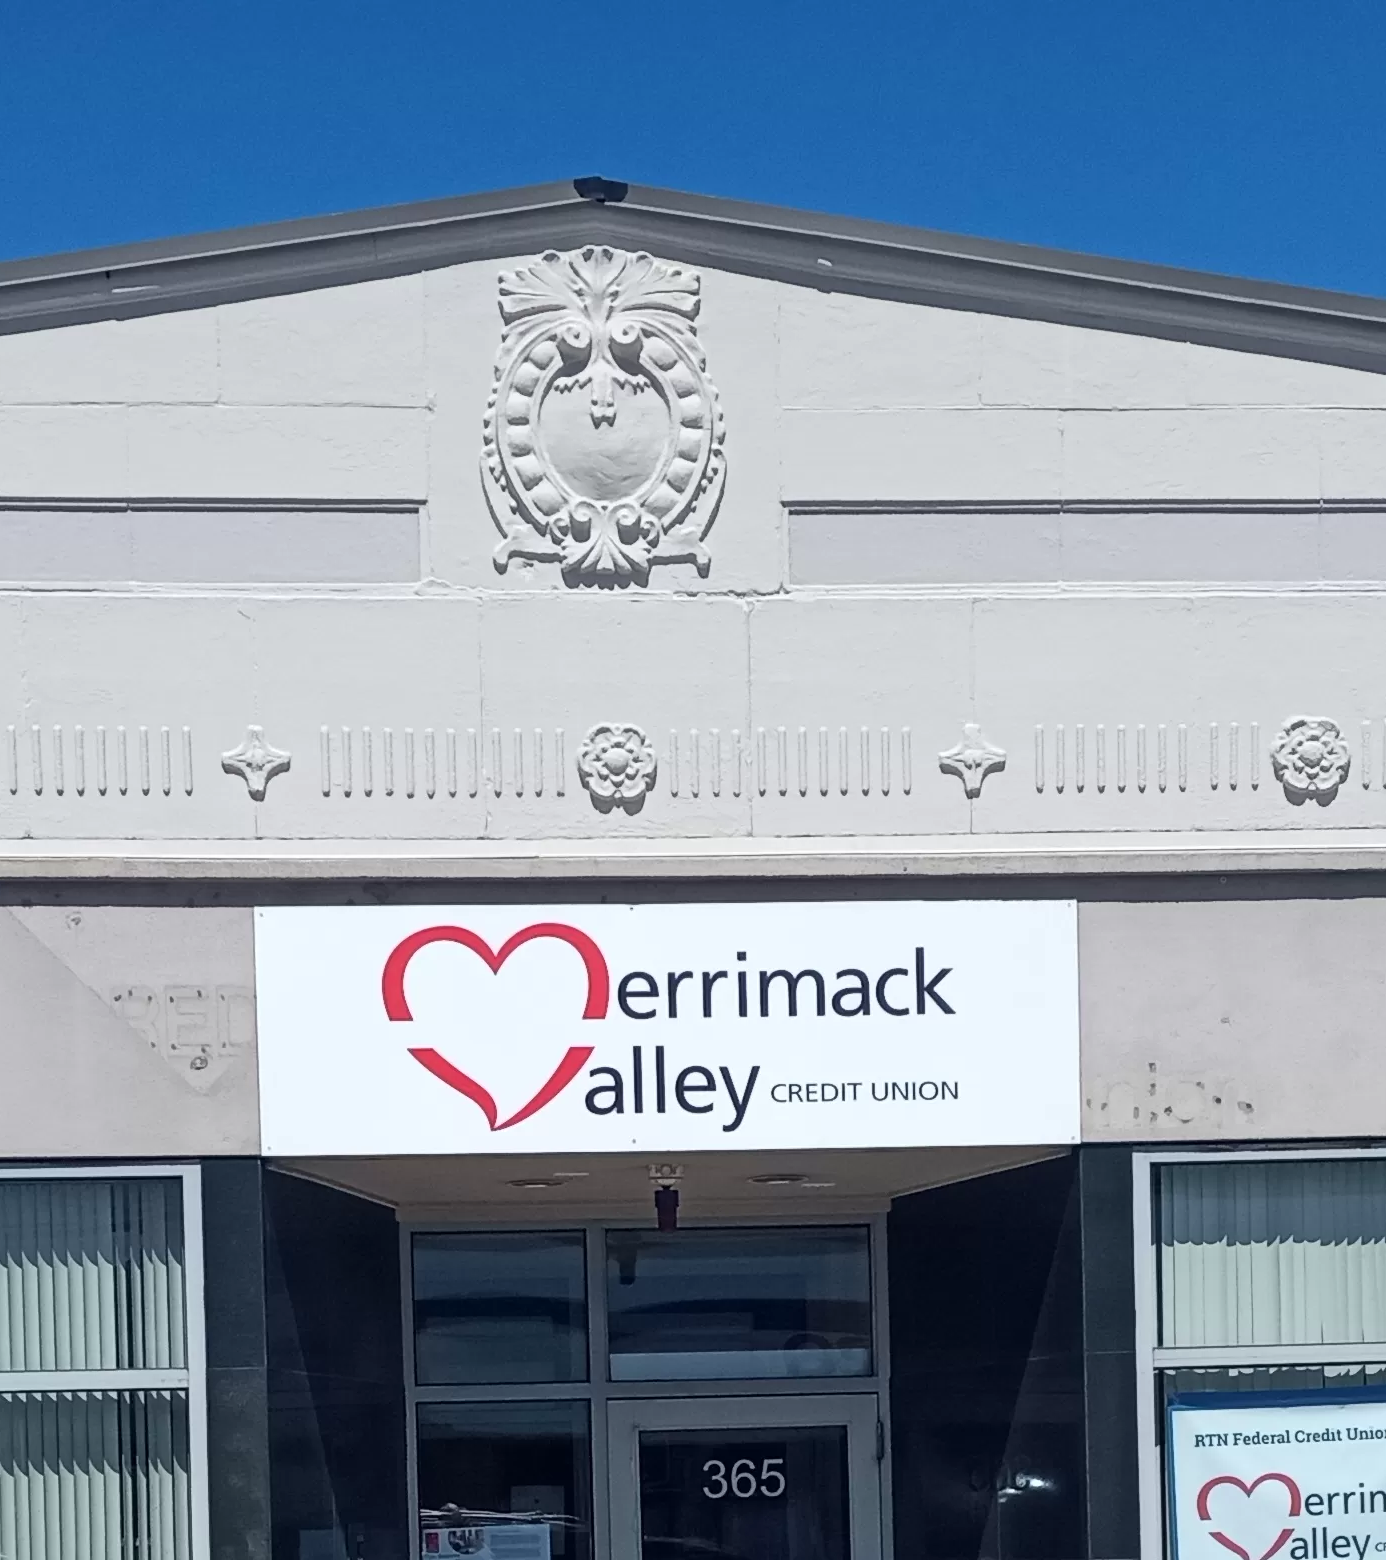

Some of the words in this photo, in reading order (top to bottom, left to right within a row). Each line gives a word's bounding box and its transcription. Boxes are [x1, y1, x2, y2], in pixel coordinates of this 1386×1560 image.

[770, 1083, 862, 1105] CREDIT
[871, 1080, 959, 1102] UNION
[1194, 1433, 1229, 1447] RTN
[1233, 1431, 1291, 1446] Federal
[1294, 1428, 1342, 1444] Credit
[703, 1459, 785, 1499] 365
